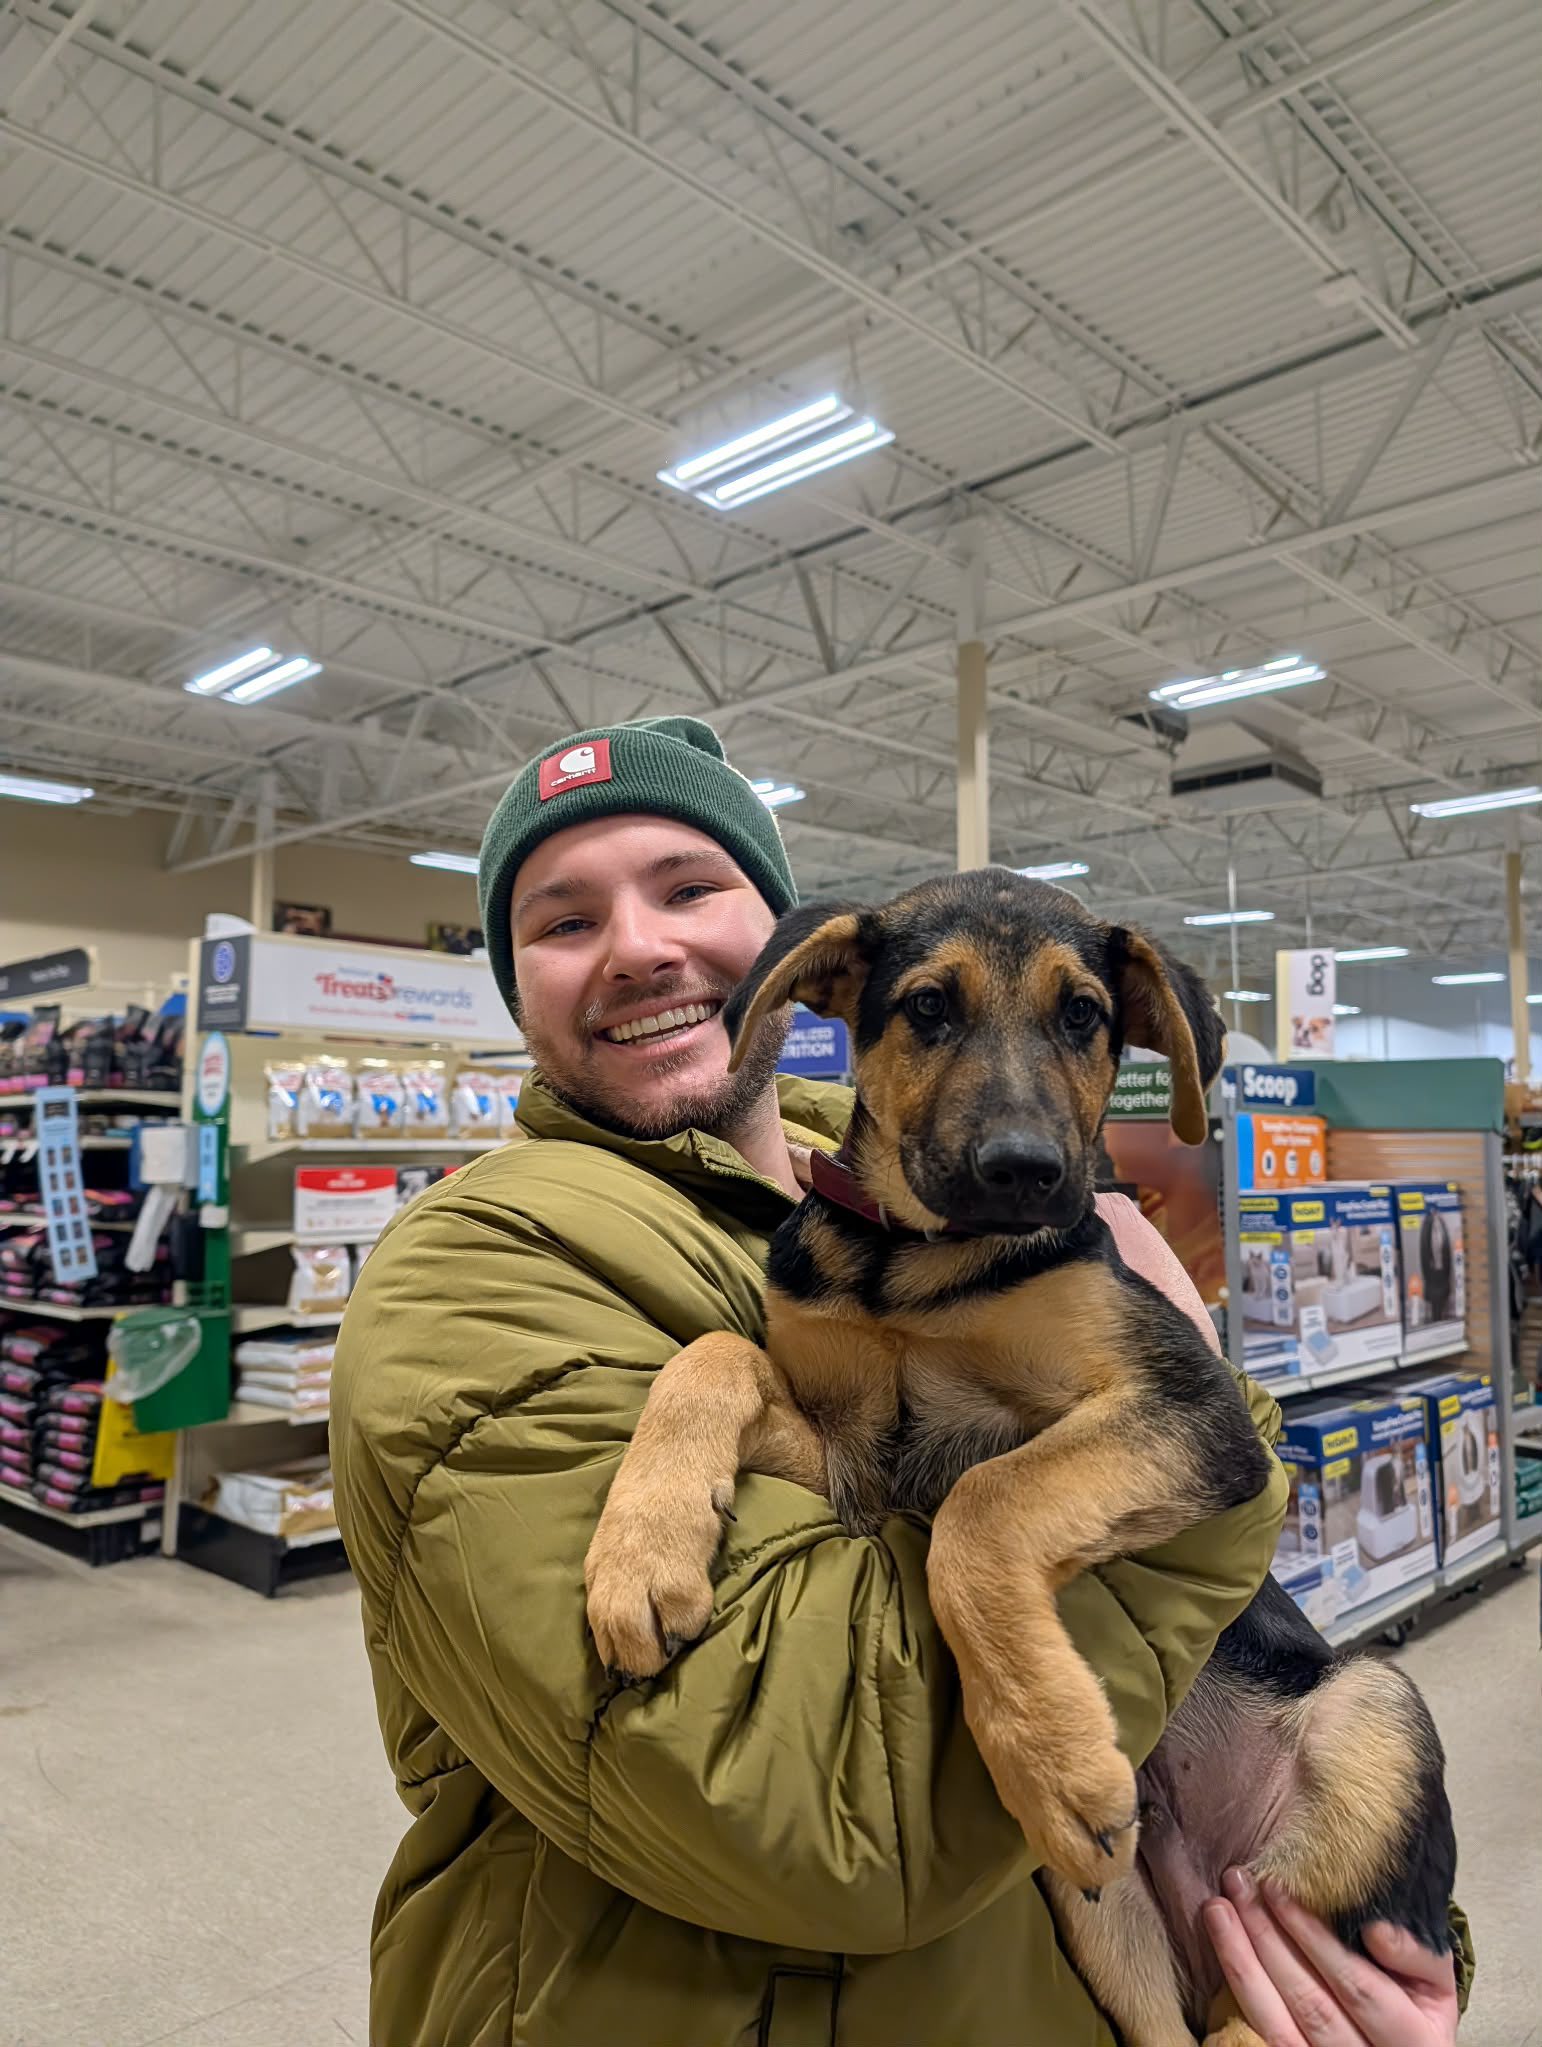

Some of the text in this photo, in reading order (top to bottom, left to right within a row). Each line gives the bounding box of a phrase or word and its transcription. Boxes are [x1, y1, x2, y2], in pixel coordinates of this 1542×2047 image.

[550, 768, 597, 786] carhartt
[314, 971, 474, 1010] Treats rewards
[1306, 953, 1329, 996] dog
[1116, 1069, 1172, 1088] etter fo
[1243, 1066, 1299, 1107] Scoop
